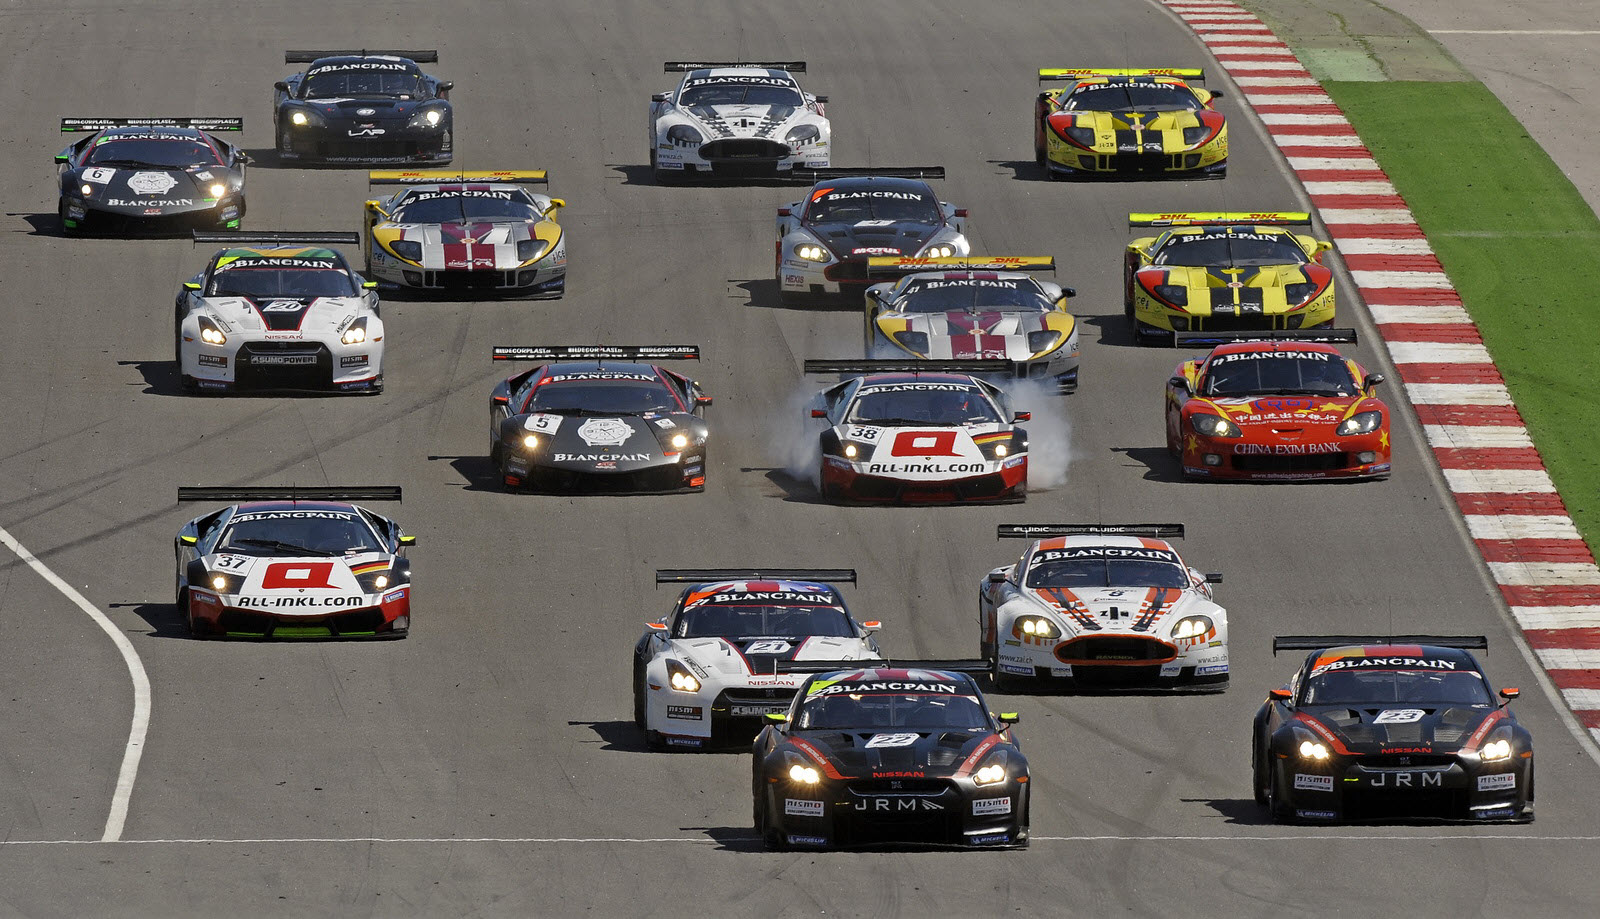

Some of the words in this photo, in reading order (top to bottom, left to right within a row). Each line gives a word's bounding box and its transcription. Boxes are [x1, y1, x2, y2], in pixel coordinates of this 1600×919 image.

[320, 64, 406, 72] BLANCPAIN
[692, 78, 790, 86] BLANCPAIN
[1088, 82, 1176, 91] BLANCPAIN
[92, 170, 102, 178] 6
[418, 191, 512, 200] BLANCPAIN
[828, 192, 922, 201] BLANCPAIN
[107, 198, 193, 206] BLANCPAIN
[1182, 233, 1278, 243] BLANCPAIN
[854, 247, 899, 255] MOTUL
[234, 258, 334, 268] BLANCPAIN
[785, 274, 804, 284] HEXIS
[926, 280, 1017, 290] BLANCPAIN
[270, 301, 301, 309] 20
[1226, 352, 1328, 362] BLANCPAIN
[868, 385, 970, 394] BLANCPAIN
[536, 418, 550, 428] 5
[851, 428, 878, 440] 38
[1234, 444, 1272, 454] CHINA
[1276, 444, 1306, 454] EXIM
[1309, 442, 1342, 454] BANK
[554, 453, 650, 462] BLANCPAIN
[869, 463, 986, 473] ALL-INKL.COM
[240, 512, 352, 522] BLANCPAIN
[1044, 550, 1172, 560] BLANCPAIN
[218, 556, 246, 569] 37
[238, 596, 363, 607] ALL-INKL.COM
[714, 592, 833, 604] BLANCPAIN
[754, 643, 785, 651] 21
[998, 654, 1033, 664] www.zai.ch
[1198, 654, 1228, 664] www.zai.ch
[1330, 658, 1456, 670] BLANCPAIN
[828, 682, 956, 694] BLANCPAIN
[1381, 712, 1415, 720] 23
[874, 736, 910, 744] 22
[1371, 772, 1442, 786] JRM
[855, 799, 916, 811] JRM
